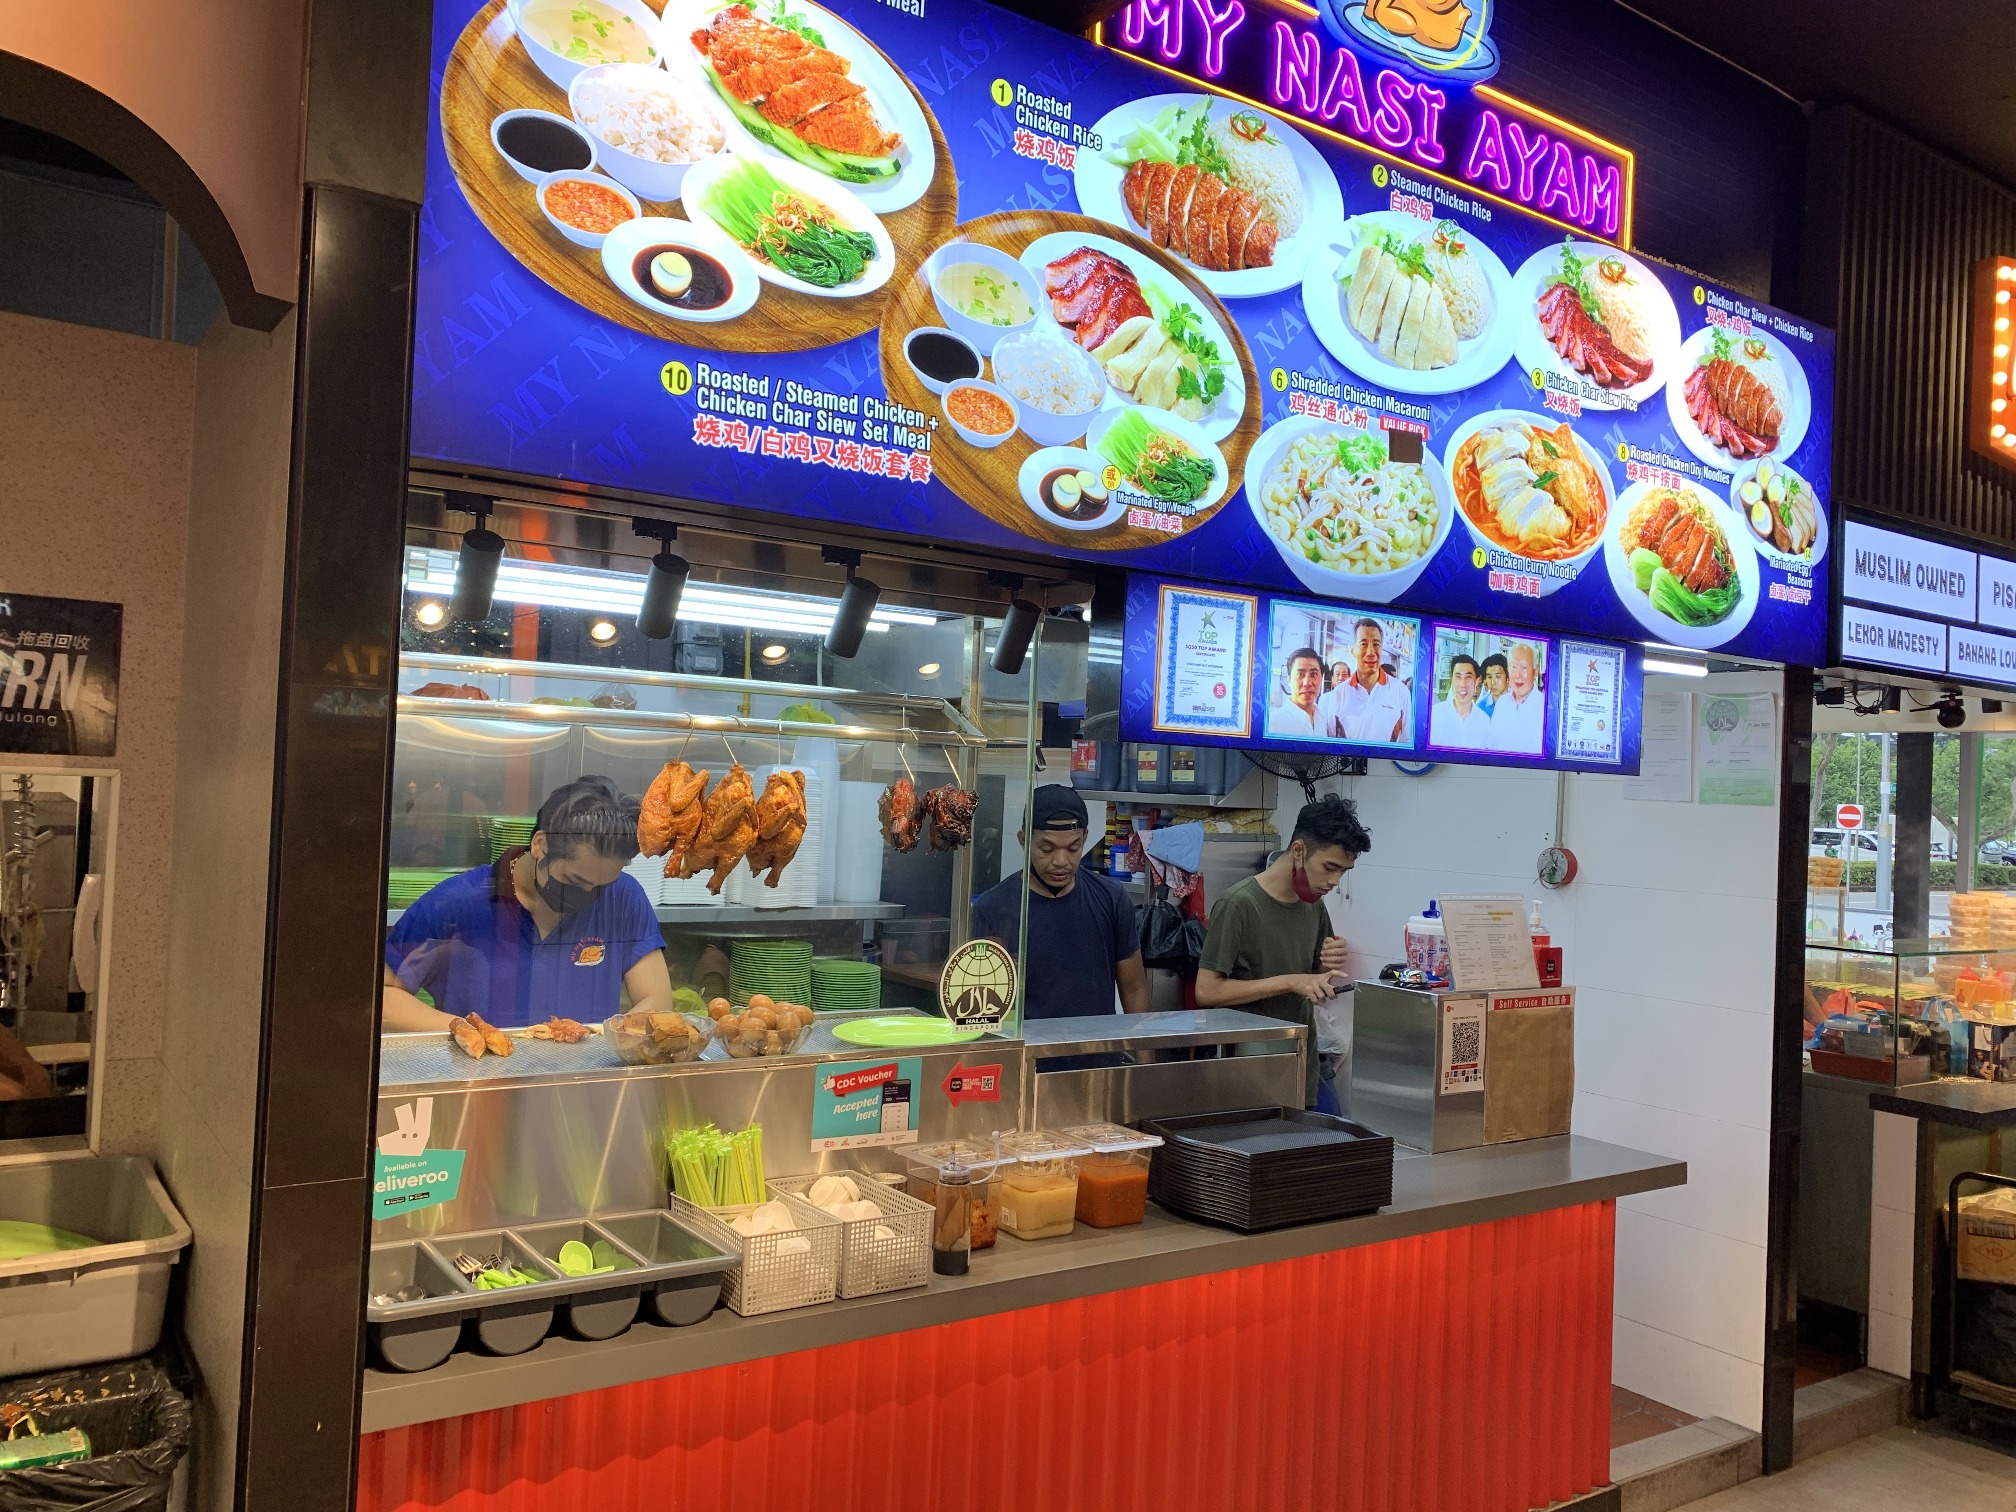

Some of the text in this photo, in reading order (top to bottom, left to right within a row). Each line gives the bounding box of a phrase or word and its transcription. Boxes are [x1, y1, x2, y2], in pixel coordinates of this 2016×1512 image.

[1017, 84, 1072, 120] Roasted
[1121, 0, 1621, 234] MY NASI AYAM
[1016, 105, 1102, 150] Chicken Rice
[1014, 128, 1077, 171] 烧鸡饭
[1390, 170, 1432, 200] Steamed
[1434, 185, 1470, 214] Chicken
[1471, 200, 1492, 222] Rice
[1390, 188, 1434, 222] 白鸡饭
[1705, 306, 1752, 336] 叉烧+鸡饭
[1707, 290, 1734, 311] Chicken
[1735, 300, 1751, 318] Char
[1752, 308, 1768, 325] Siew
[1768, 317, 1774, 326] +
[1774, 316, 1798, 336] Chicken
[1799, 327, 1814, 343] Rice
[665, 362, 939, 431] 10 Roasted / Steamed Chicken +
[1291, 371, 1341, 399] Shredded
[1344, 384, 1383, 410] Chicken
[1385, 395, 1431, 422] Macaroni
[1544, 390, 1582, 418] 叉烧饭
[1546, 371, 1578, 395] Chicken
[1580, 381, 1600, 401] Char
[1600, 388, 1620, 407] Siew
[1621, 394, 1638, 412] Rice
[697, 387, 932, 452] Chicken Char Siew Set Meal
[1290, 392, 1369, 430] 鸡丝通心粉
[694, 414, 932, 483] 烧鸡/白鸡叉烧饭套餐
[1626, 460, 1682, 490] 烧鸡干捞面
[1630, 444, 1660, 466] Roasted
[1662, 452, 1689, 472] Chicken
[1690, 462, 1702, 480] Dry
[1704, 466, 1730, 486] Noodles
[1117, 492, 1153, 508] Marinated
[1489, 550, 1524, 571] Chicken
[1526, 557, 1548, 578] Curry
[1549, 562, 1578, 580] Noodle
[1770, 555, 1798, 572] Marinated
[1798, 562, 1808, 578] Egg
[1788, 572, 1812, 588] Beancurd
[1854, 549, 1966, 598] MUSLIM OWNED
[1489, 570, 1542, 598] 咖喱鸡面
[1993, 581, 2016, 610] PIS
[1198, 629, 1218, 641] TOP
[1848, 621, 1939, 656] LEKOR MAJESTY
[1958, 641, 1997, 667] BANANA
[1586, 674, 1600, 682] TOP
[1500, 998, 1538, 1008] Self Service
[1542, 996, 1566, 1006] 自助服务
[956, 1024, 999, 1032] SINGAPORE
[836, 1069, 892, 1090] CDC Voucher
[833, 1095, 880, 1114] Accepted
[856, 1108, 878, 1122] here
[384, 1162, 416, 1172] Available
